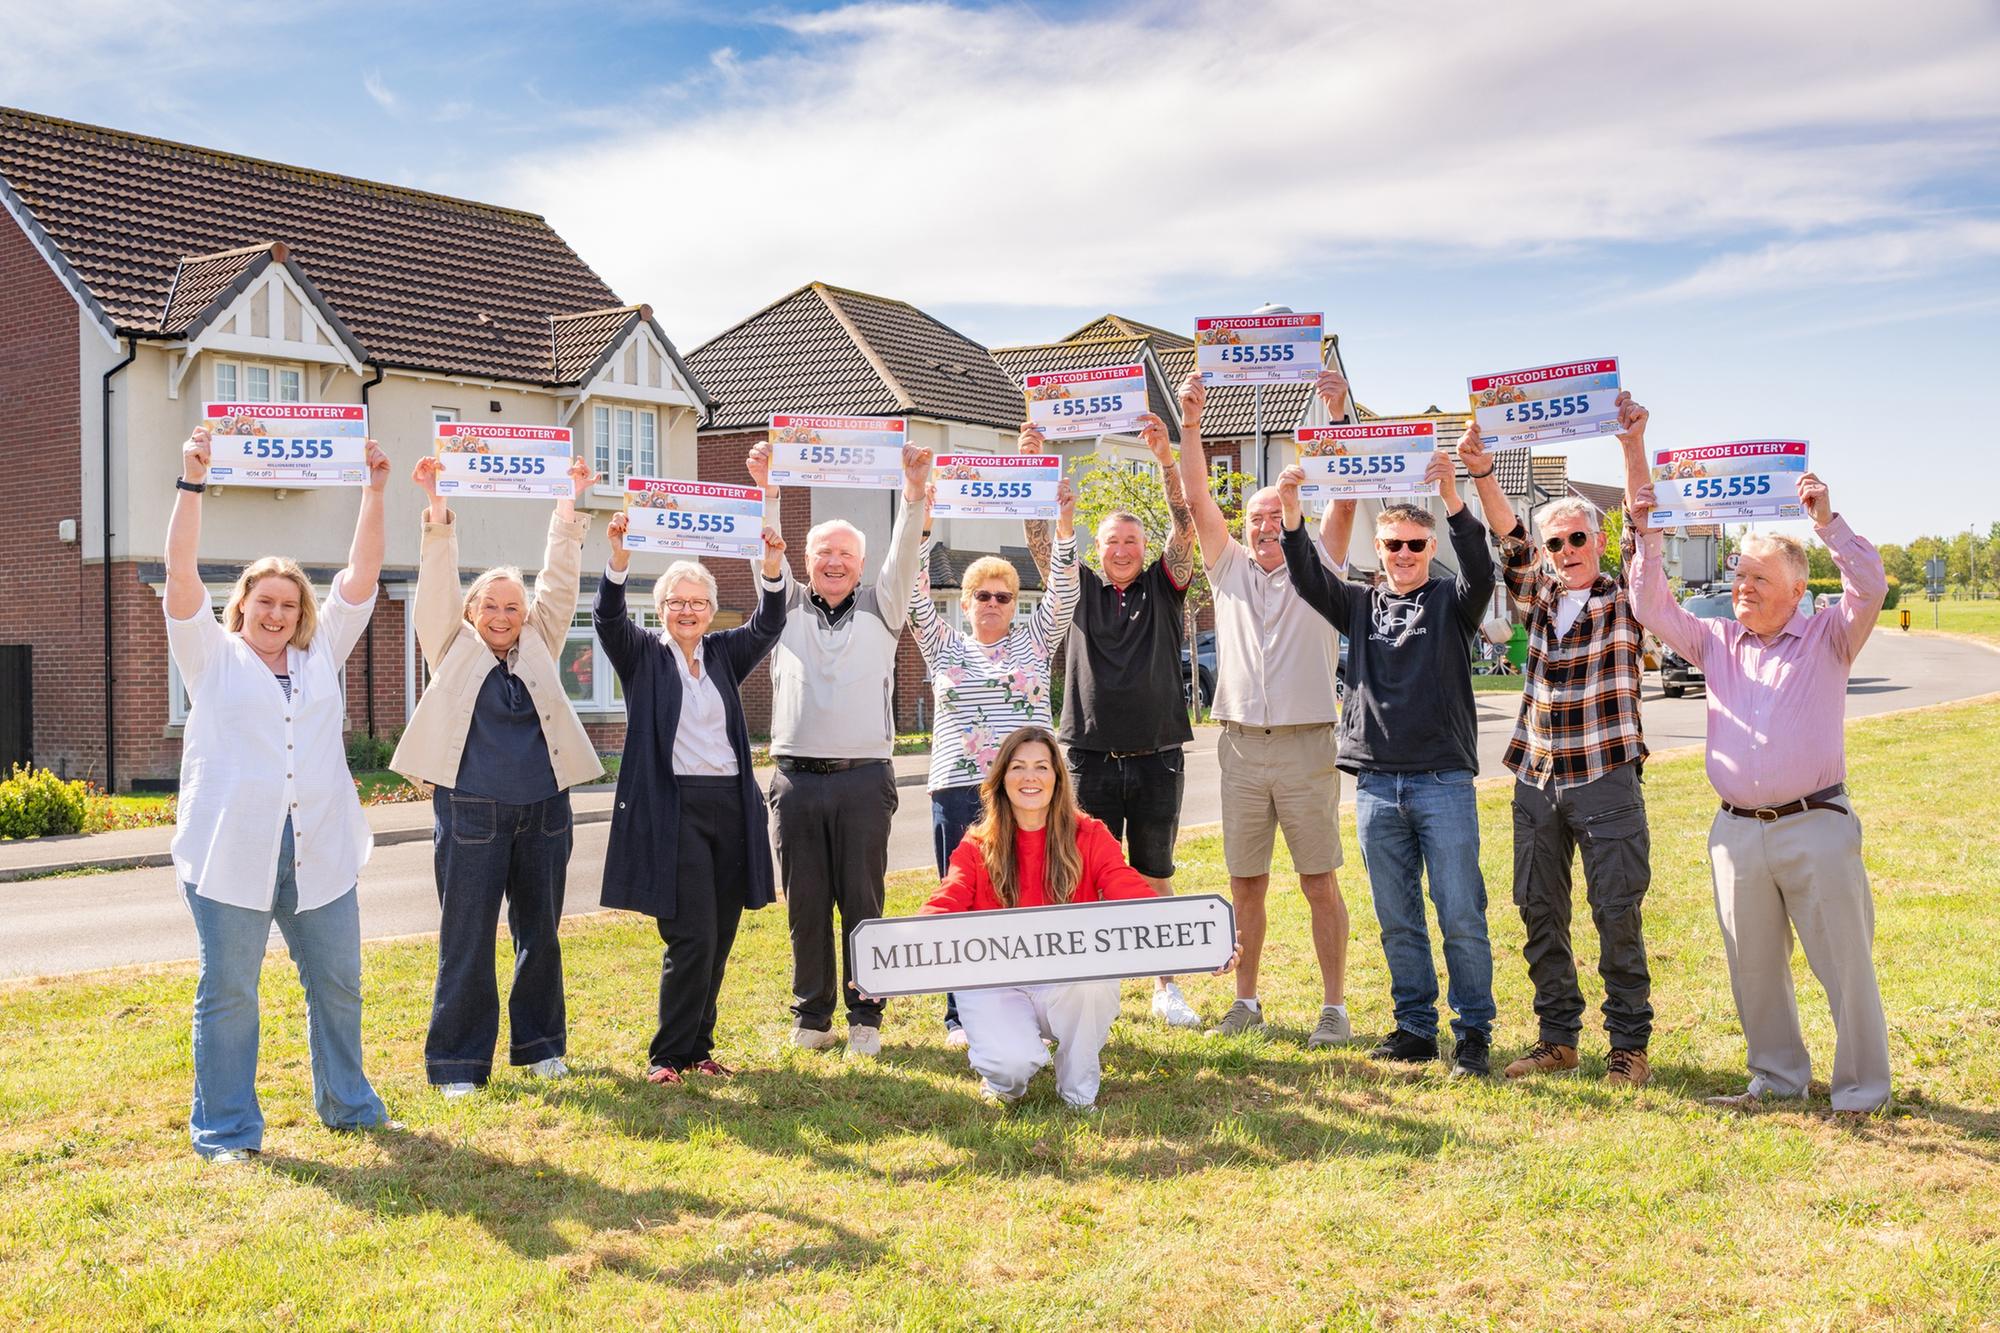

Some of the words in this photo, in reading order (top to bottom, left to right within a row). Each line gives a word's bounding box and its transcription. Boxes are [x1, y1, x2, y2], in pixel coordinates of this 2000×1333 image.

[1210, 319, 1260, 328] POSTCODE
[1263, 317, 1304, 326] LOTTERY
[1040, 373, 1088, 384] POSTCODE
[1091, 369, 1130, 379] LOTTERY
[1489, 371, 1546, 387] POSTCODE
[1550, 363, 1599, 378] LOTTERY
[227, 406, 290, 417] POSTCODE
[294, 408, 345, 418] LOTTERY
[789, 418, 841, 428] POSTCODE
[844, 419, 888, 429] LOTTERY
[456, 426, 510, 437] POSTCODE
[513, 428, 556, 438] LOTTERY
[1314, 428, 1368, 439] POSTCODE
[1370, 426, 1416, 436] LOTTERY
[1673, 446, 1731, 460] POSTCODE
[1734, 444, 1786, 455] LOTTERY
[646, 482, 700, 494] POSTCODE
[703, 486, 747, 498] LOTTERY
[872, 931, 1087, 970] MILLIONAIRE
[1095, 921, 1215, 952] STREET
